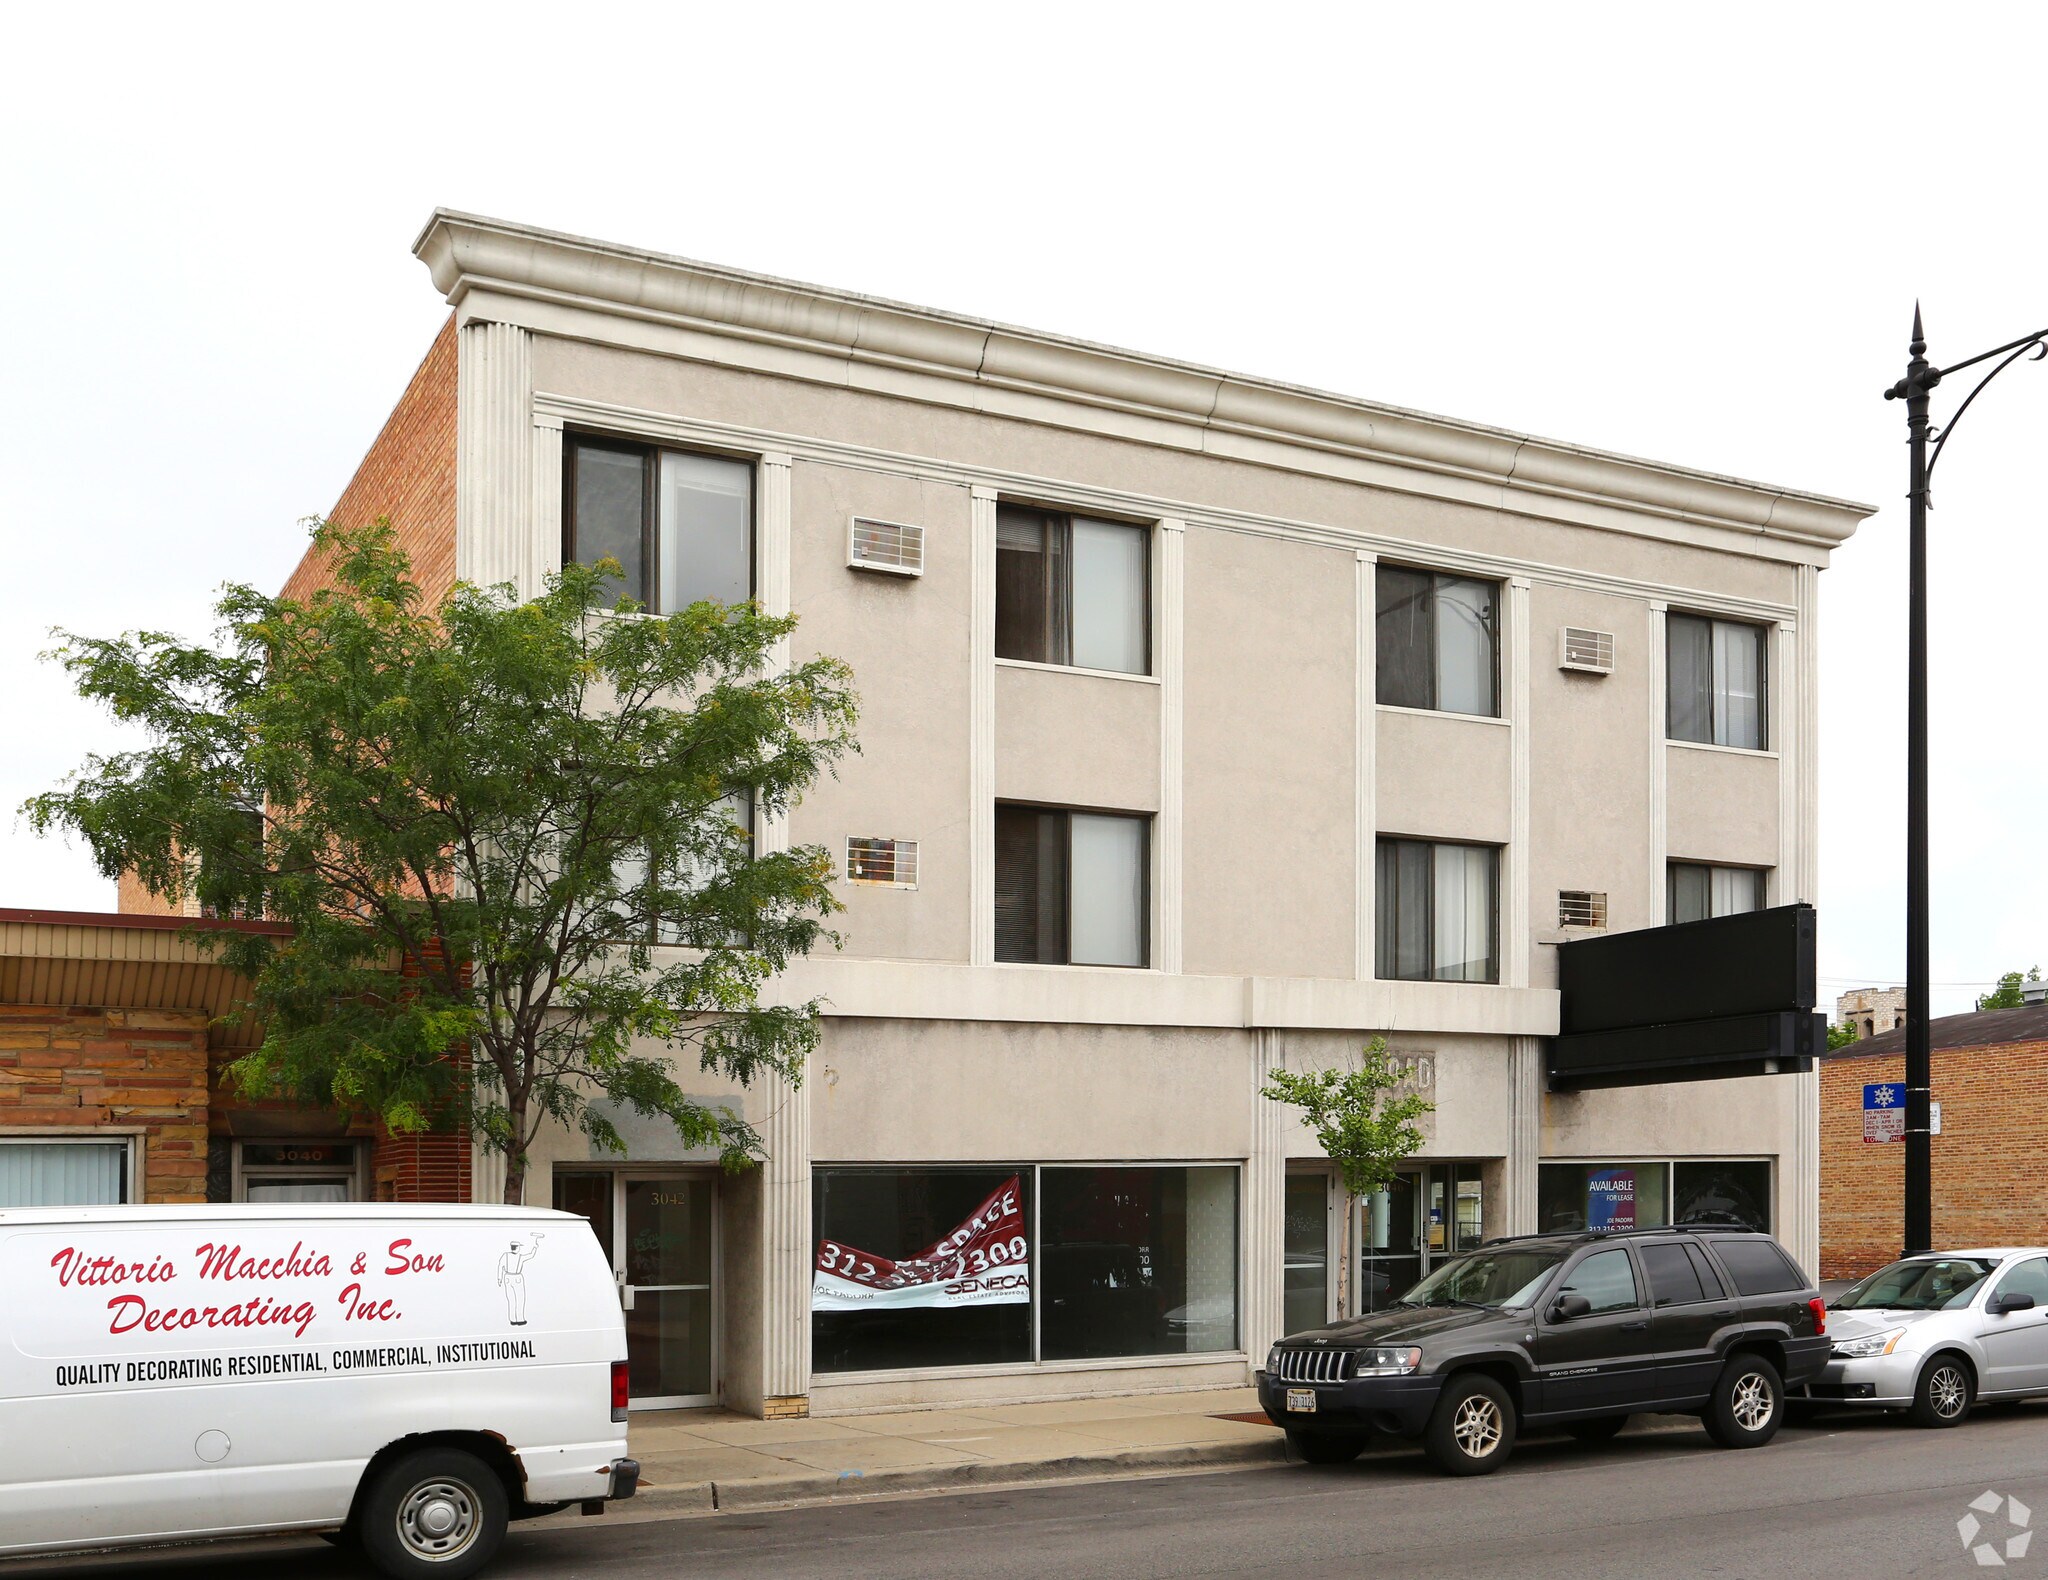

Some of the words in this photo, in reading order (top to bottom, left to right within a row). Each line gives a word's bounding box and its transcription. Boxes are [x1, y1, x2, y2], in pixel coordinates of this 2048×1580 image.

[277, 1151, 322, 1160] 3040
[1589, 1180, 1634, 1191] AVAILABLE
[651, 1193, 685, 1205] 3042
[51, 1247, 176, 1286] Vittorio
[195, 1241, 332, 1281] Macchia
[351, 1253, 367, 1276] &
[385, 1238, 445, 1276] Son
[944, 1274, 1029, 1296] SENECA
[107, 1294, 315, 1338] Decorating
[338, 1282, 402, 1322] Inc.
[56, 1363, 121, 1387] QUALITY
[126, 1357, 222, 1382] DECORATING
[228, 1352, 328, 1376] RESIDENTIAL,
[333, 1346, 432, 1370] COMMERCIAL,
[437, 1340, 536, 1364] INSTITUTIONAL
[1569, 1367, 1598, 1375] CHEROKEE
